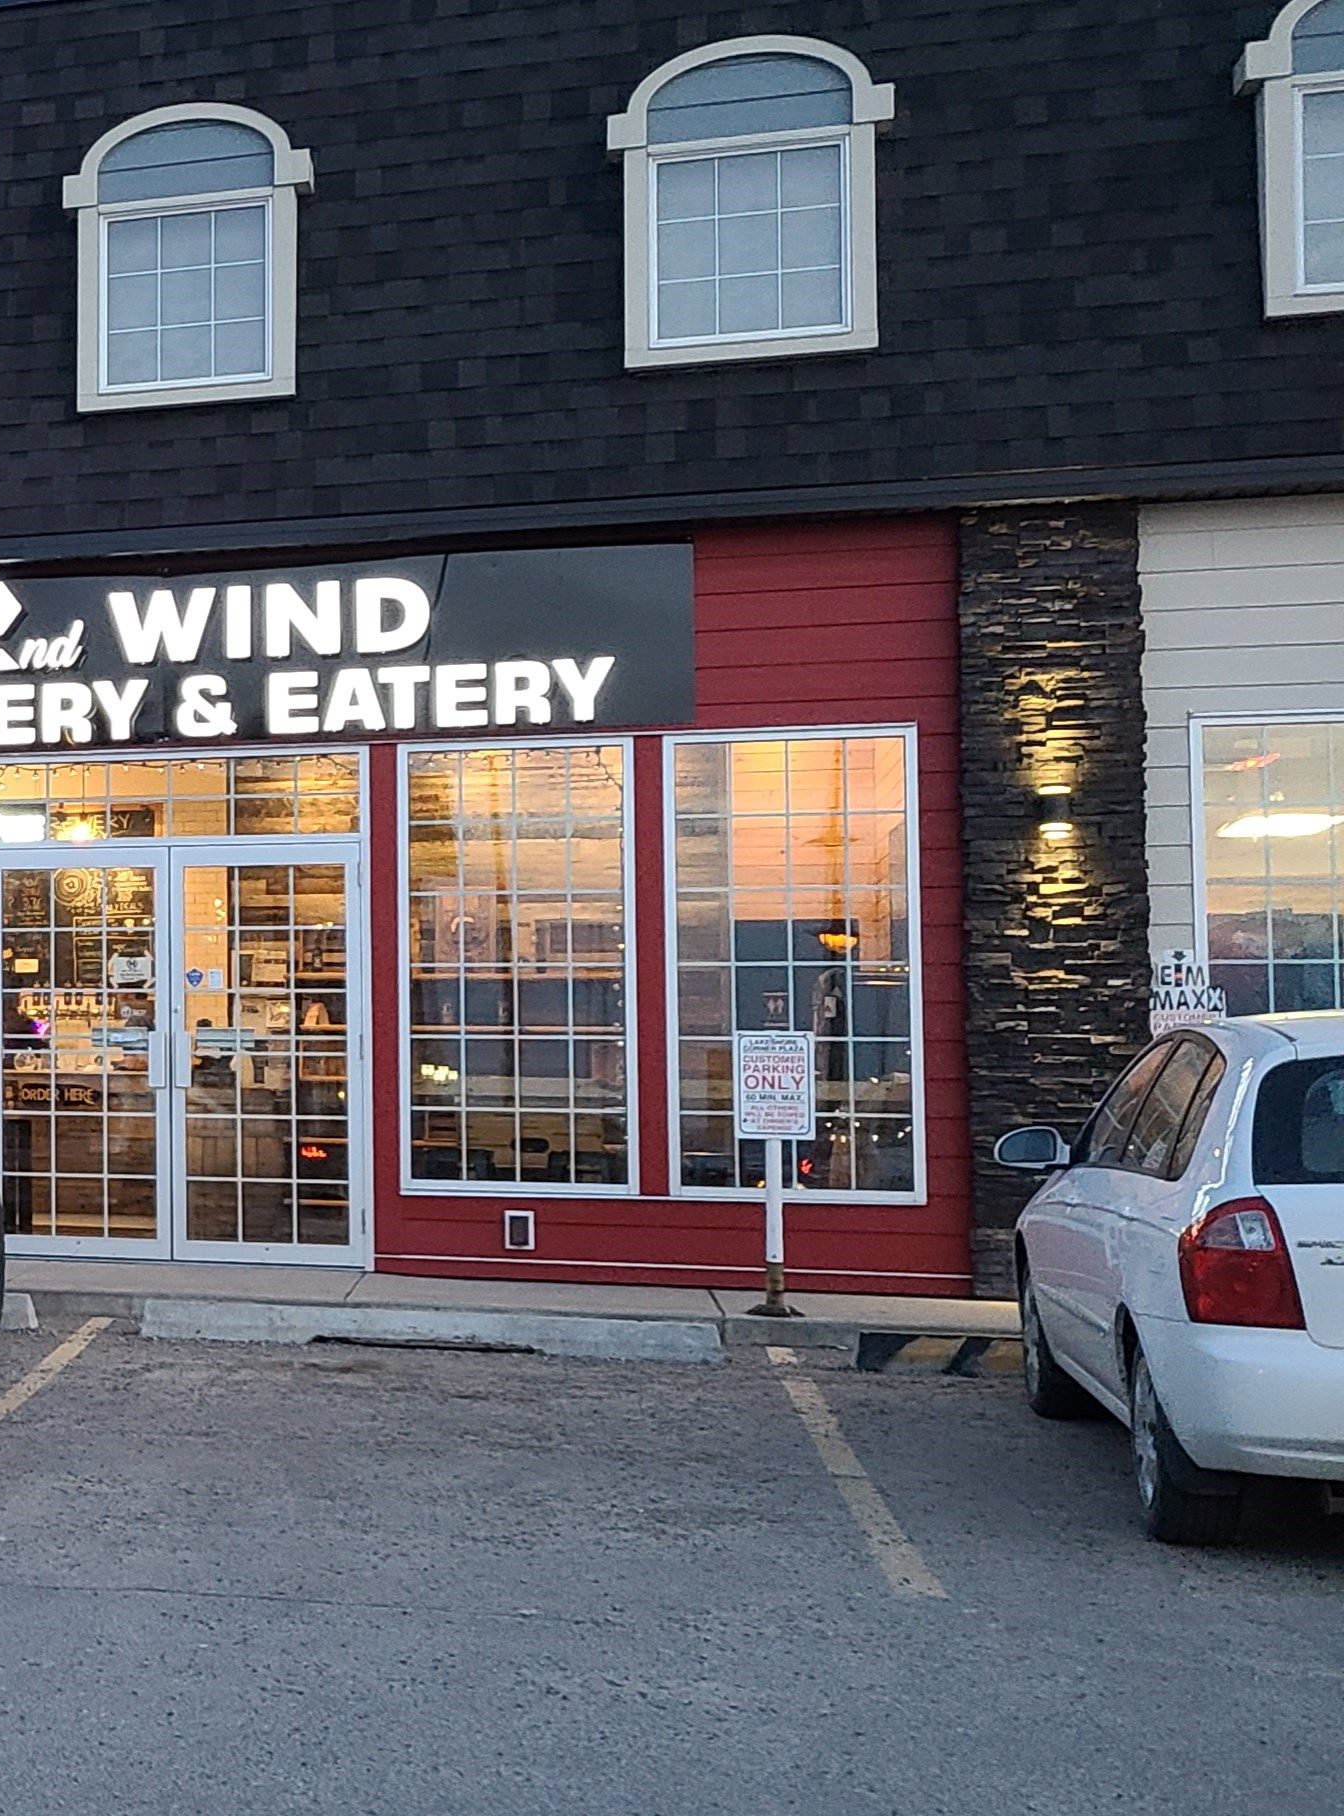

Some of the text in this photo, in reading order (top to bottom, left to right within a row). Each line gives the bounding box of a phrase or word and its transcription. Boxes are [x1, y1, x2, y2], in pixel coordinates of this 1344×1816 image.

[108, 577, 431, 664] WIND
[176, 673, 237, 738] &
[266, 656, 616, 735] EATERY
[1151, 986, 1224, 1011] MAXX
[743, 1055, 805, 1064] CUSTOMER
[743, 1063, 806, 1074] PARKING
[744, 1074, 805, 1091] ONLY
[21, 1088, 96, 1104] ORDER HERE
